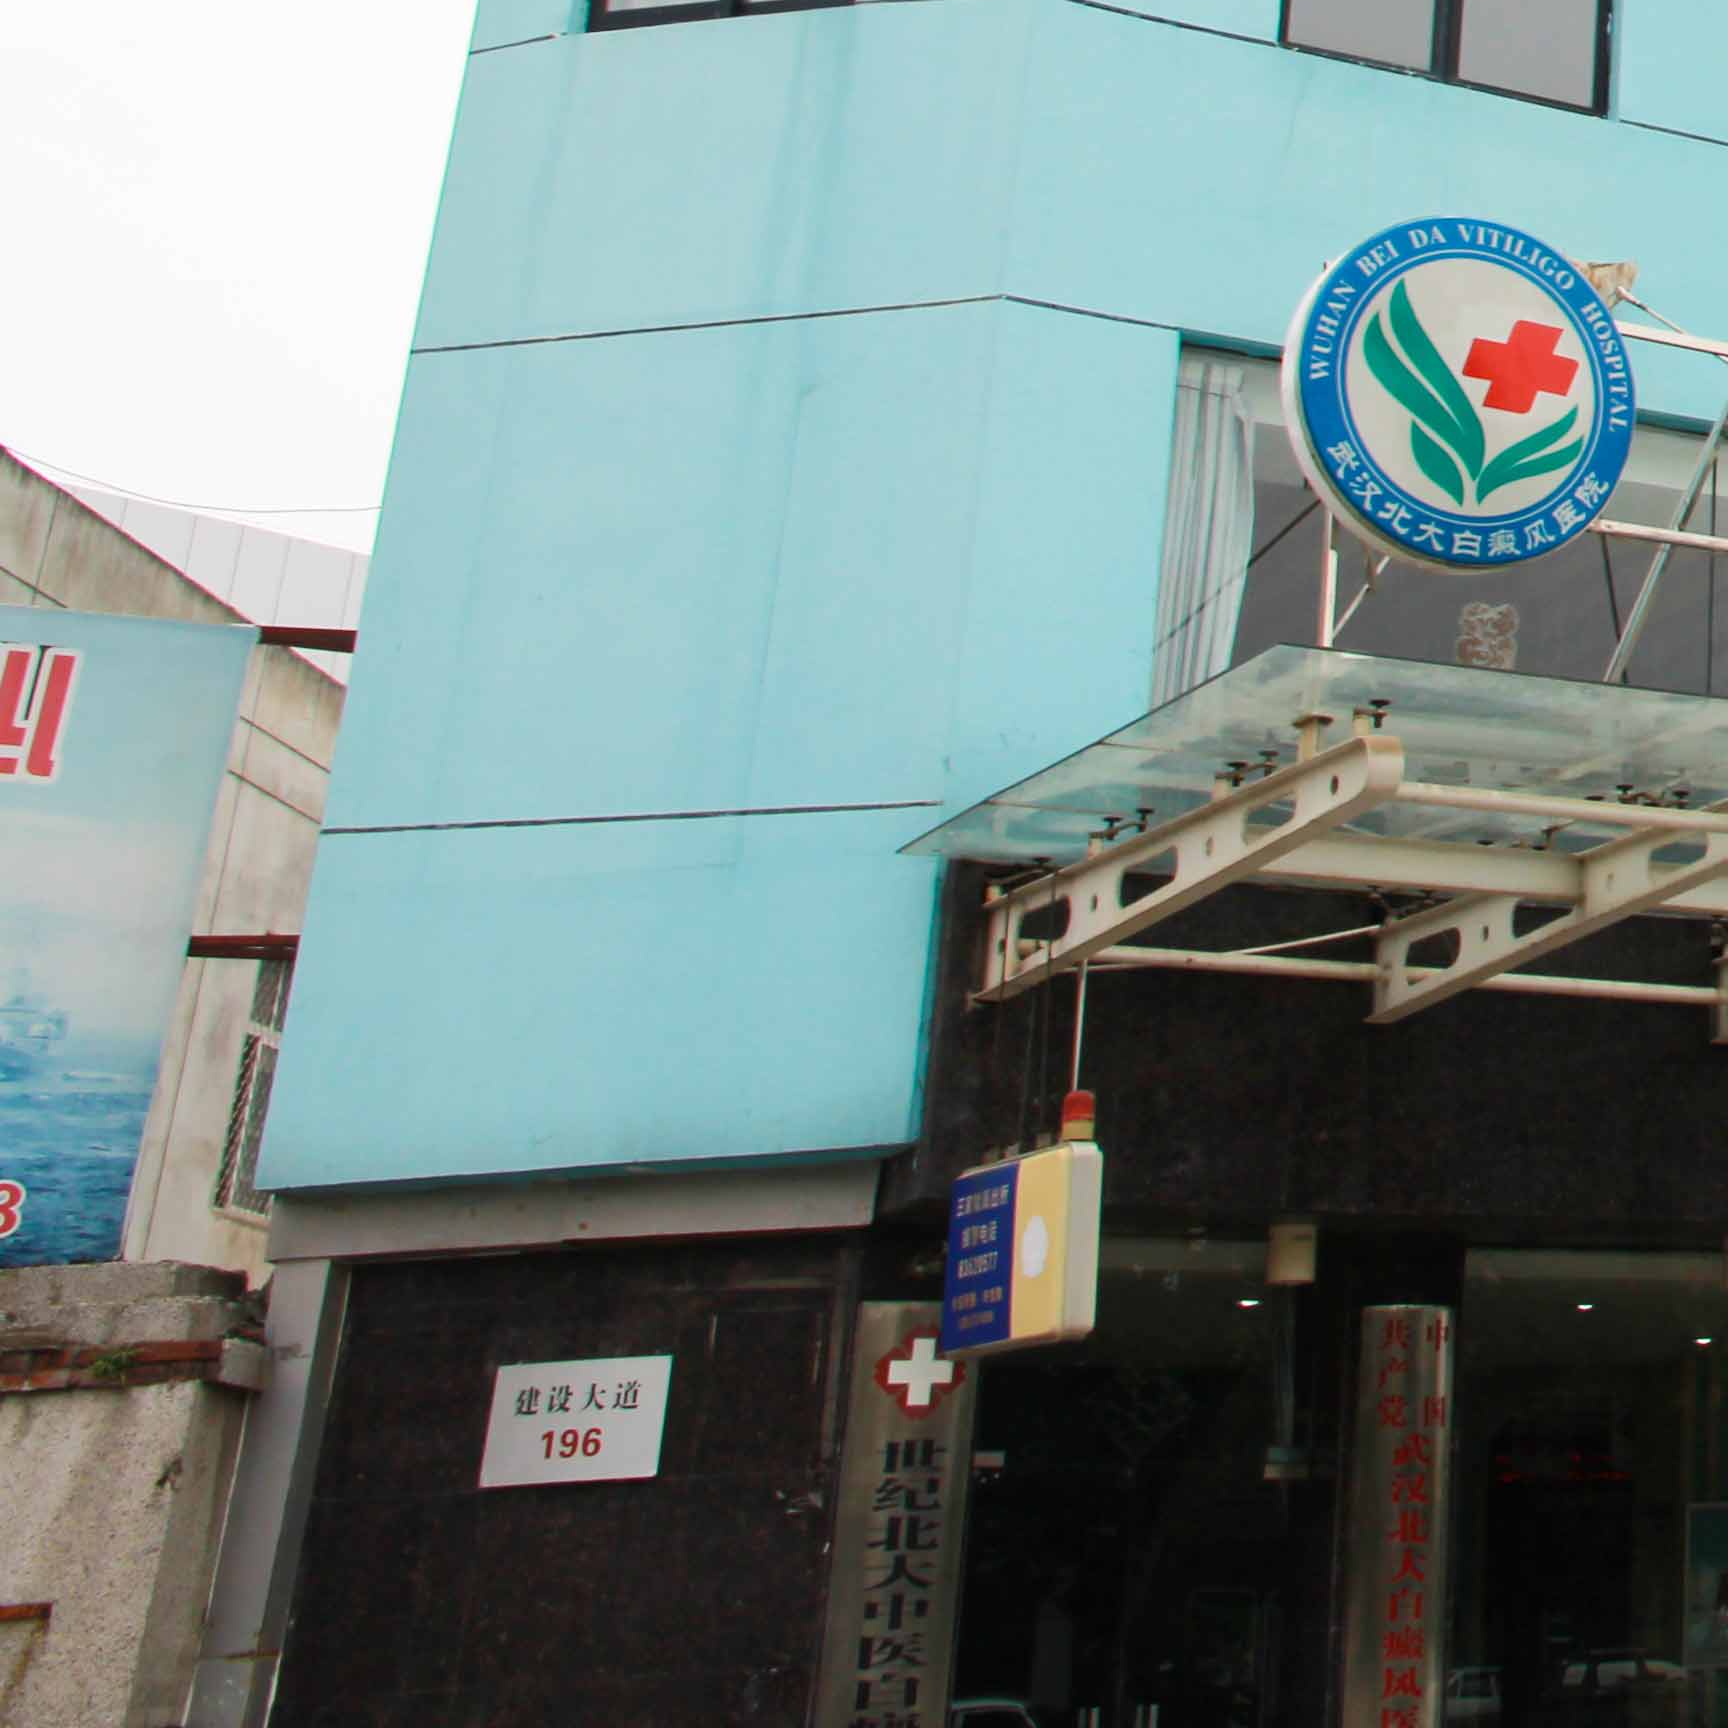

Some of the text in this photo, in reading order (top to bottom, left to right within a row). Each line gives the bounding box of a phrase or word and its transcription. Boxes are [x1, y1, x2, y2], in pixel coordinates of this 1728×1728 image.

[1310, 223, 1630, 434] WUHAN BEI DA VITILIGO HOSPITAL
[1327, 439, 1609, 559] 武汉北大白癜风医院
[514, 1380, 643, 1416] 建设大道
[541, 1426, 603, 1460] 196
[846, 1438, 947, 1728] 世纪北大中医白
